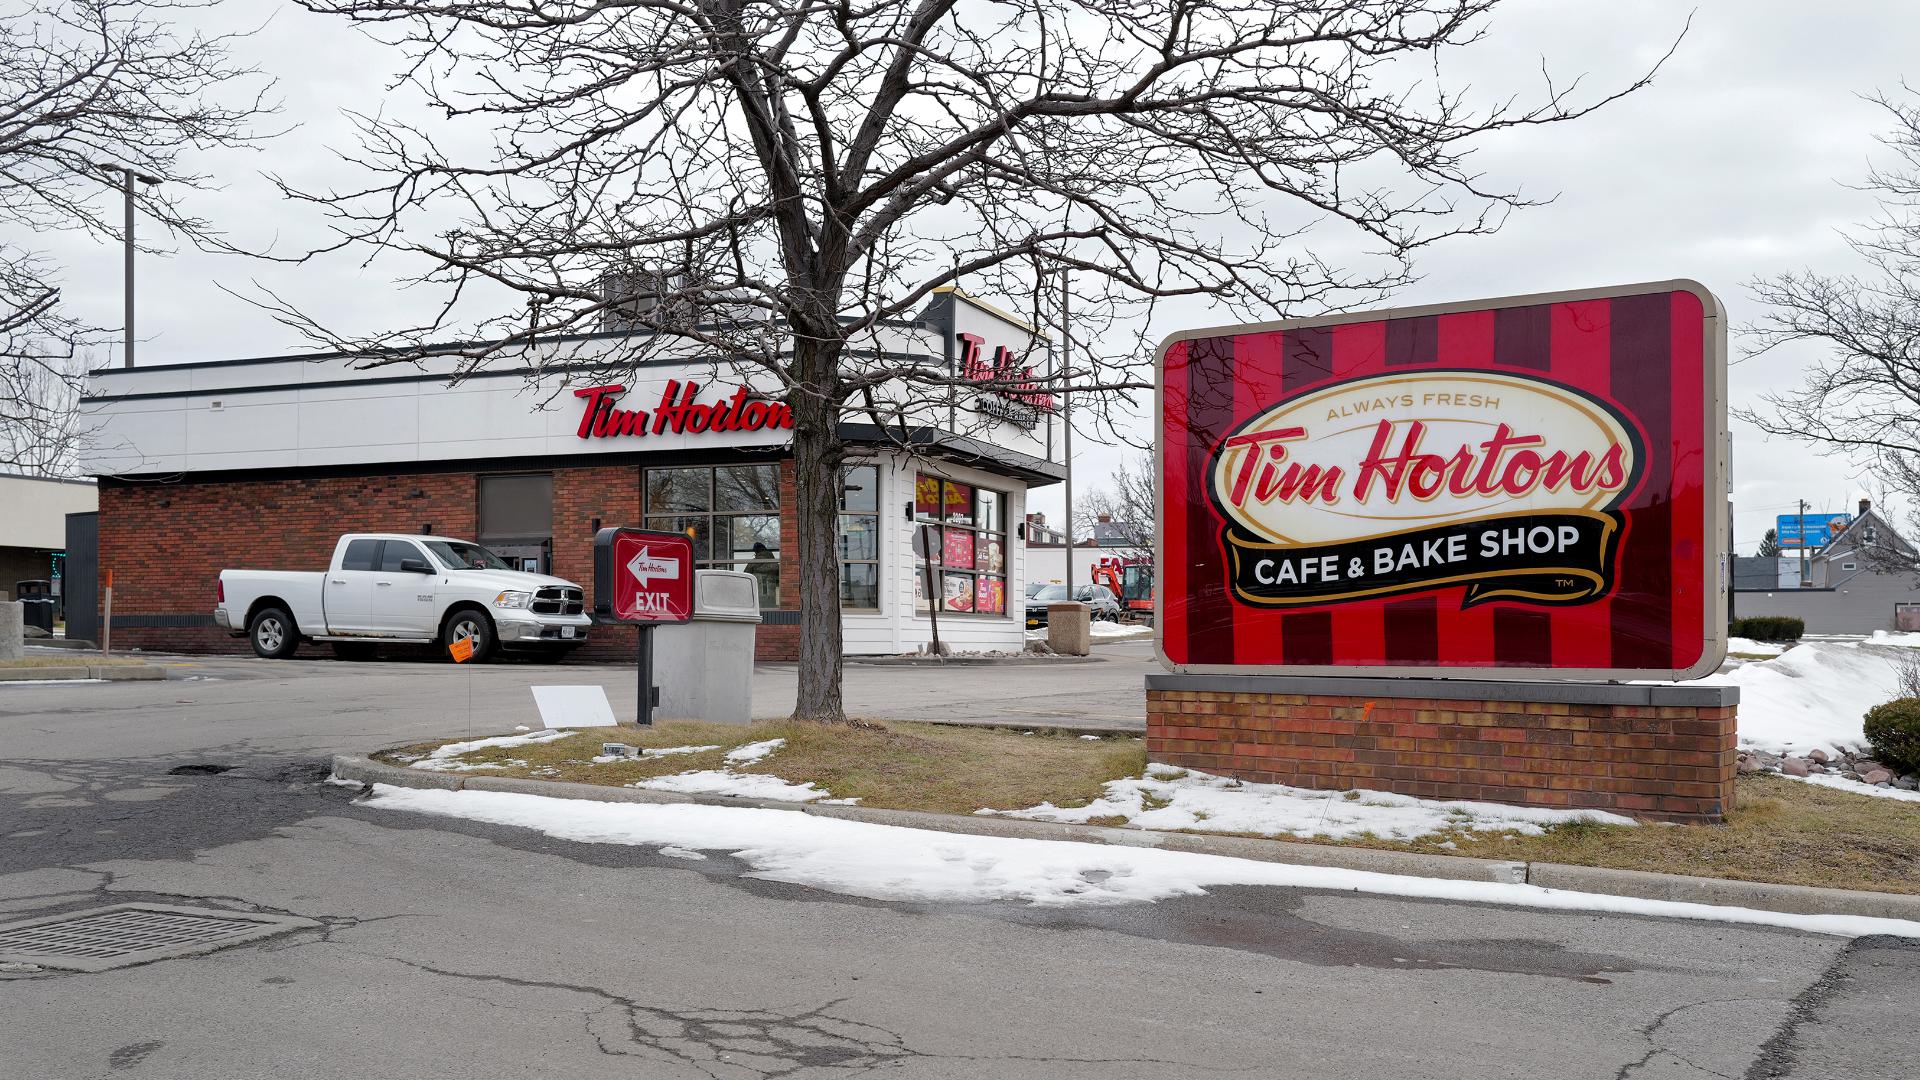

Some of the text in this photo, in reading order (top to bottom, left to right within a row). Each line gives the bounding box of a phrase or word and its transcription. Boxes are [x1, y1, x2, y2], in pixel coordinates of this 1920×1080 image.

[573, 379, 795, 439] Tim Horton
[1326, 393, 1500, 421] ALWAYS FRESH
[1225, 418, 1627, 507] Tim Hortons
[1254, 526, 1580, 584] CAFE & BAKE SHOP
[635, 592, 670, 611] EXIT
[1555, 579, 1574, 587] TM
